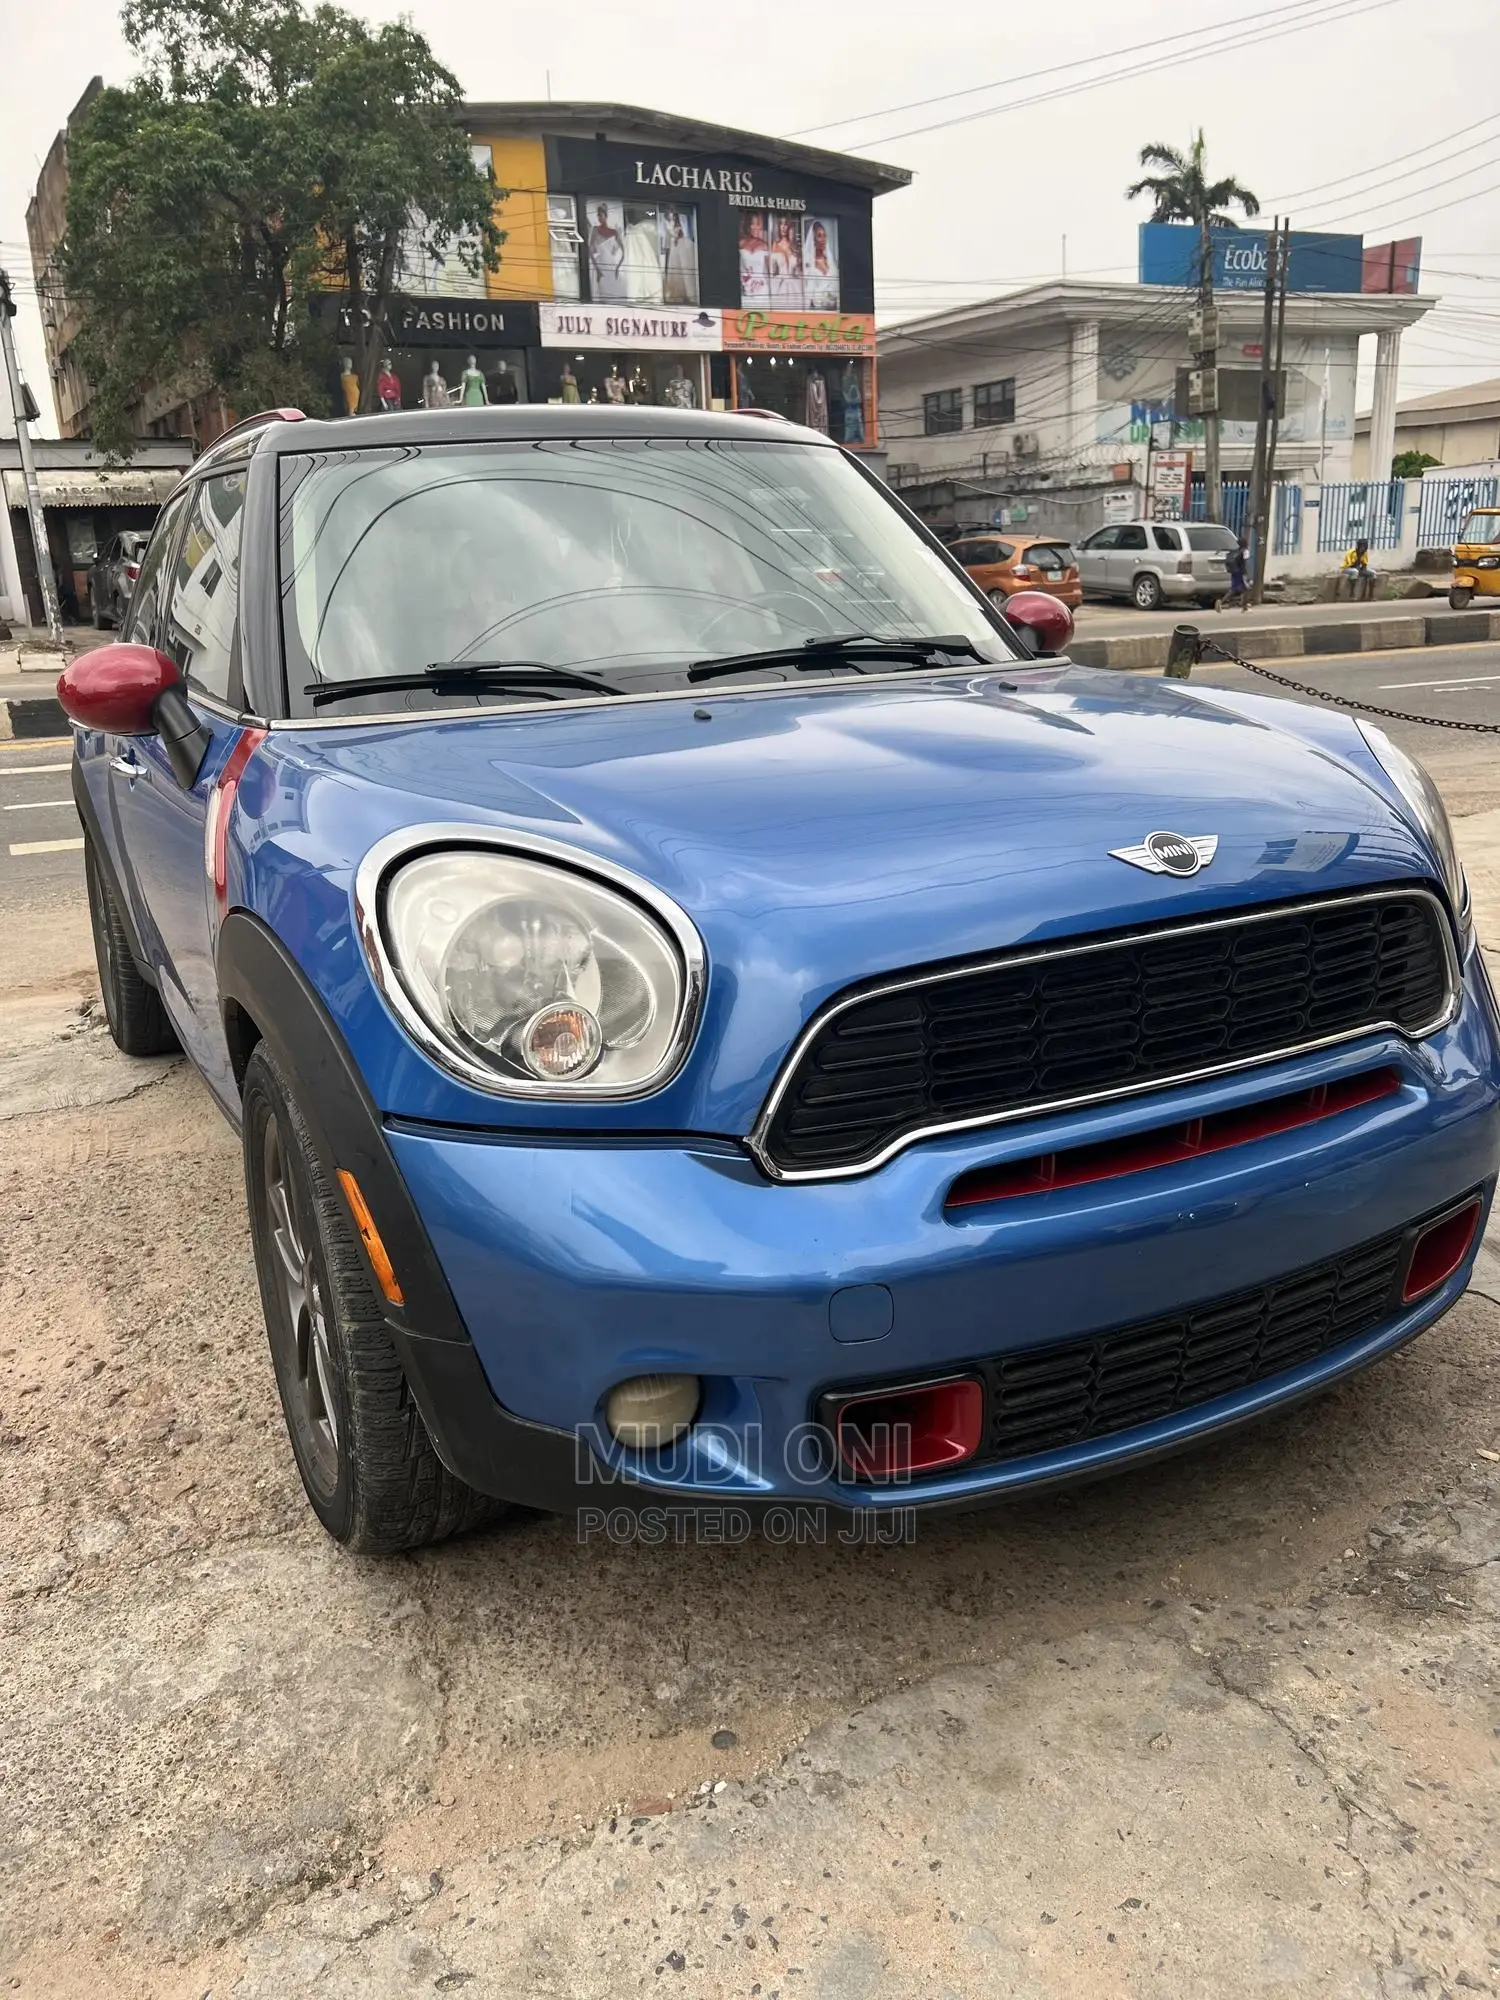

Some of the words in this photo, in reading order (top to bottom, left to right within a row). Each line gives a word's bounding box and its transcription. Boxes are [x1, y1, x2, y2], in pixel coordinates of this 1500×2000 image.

[635, 161, 753, 193] LACHARIS
[728, 194, 766, 208] BRIDAL
[767, 197, 775, 208] &
[776, 197, 806, 211] HAIRS
[1224, 243, 1291, 271] Ecoba
[403, 311, 504, 331] FASHION
[558, 315, 592, 334] JULY
[606, 317, 687, 338] SIGNATURE
[1153, 843, 1193, 859] MINI
